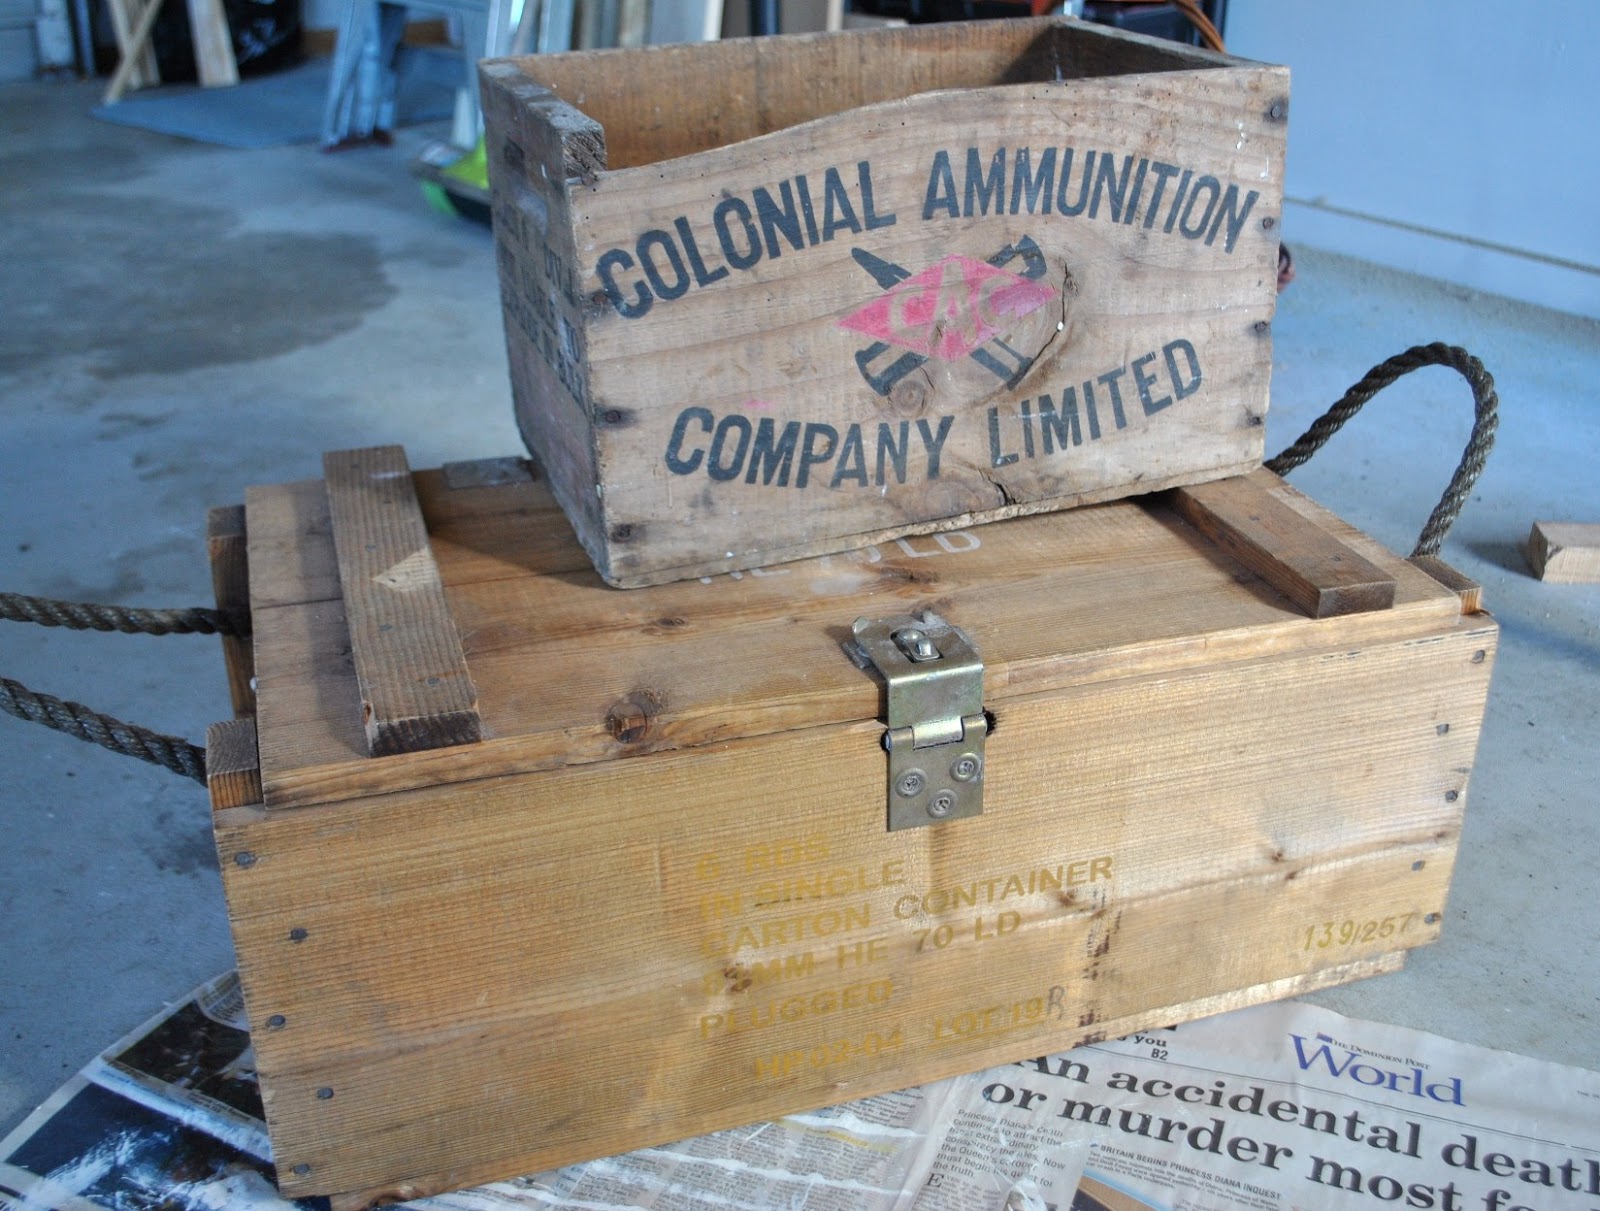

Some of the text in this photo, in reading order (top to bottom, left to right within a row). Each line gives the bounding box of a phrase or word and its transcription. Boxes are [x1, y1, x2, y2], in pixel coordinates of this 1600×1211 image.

[595, 161, 898, 320] COLONIAL
[922, 147, 1259, 254] AMMUNITION
[665, 338, 1203, 488] COMPANY LIMITED
[744, 833, 831, 875] RDS
[699, 857, 905, 922] IN SINGLE
[701, 856, 1113, 958] CARTON CONTAINER
[837, 936, 889, 969] HE
[912, 923, 954, 953] 70
[974, 910, 1021, 941] LD
[1304, 912, 1415, 951] 139/257
[698, 978, 894, 1040] PLUGGED
[933, 1004, 996, 1042] LOT
[1134, 1034, 1167, 1047] you
[1151, 1048, 1168, 1060] B2
[1330, 1038, 1431, 1070] THE DOMINION POST
[1288, 1032, 1467, 1107] World
[953, 1118, 999, 1134] continus
[958, 1109, 997, 1124] Princess
[1012, 1056, 1090, 1084] An
[1106, 1071, 1422, 1159] accidental
[941, 1143, 956, 1152] the
[959, 1146, 998, 1163] Queen's
[976, 1131, 1039, 1151] extradinary
[982, 1082, 1048, 1111] or
[1056, 1098, 1293, 1170] murder
[1305, 1155, 1462, 1211] most
[933, 1161, 948, 1170] the
[937, 1153, 962, 1163] must
[1010, 1170, 1037, 1182] qut
[1043, 1157, 1066, 1170] Now
[1101, 1145, 1282, 1200] BRITAIN BEGINS PRINCESS DIANA INQUEST
